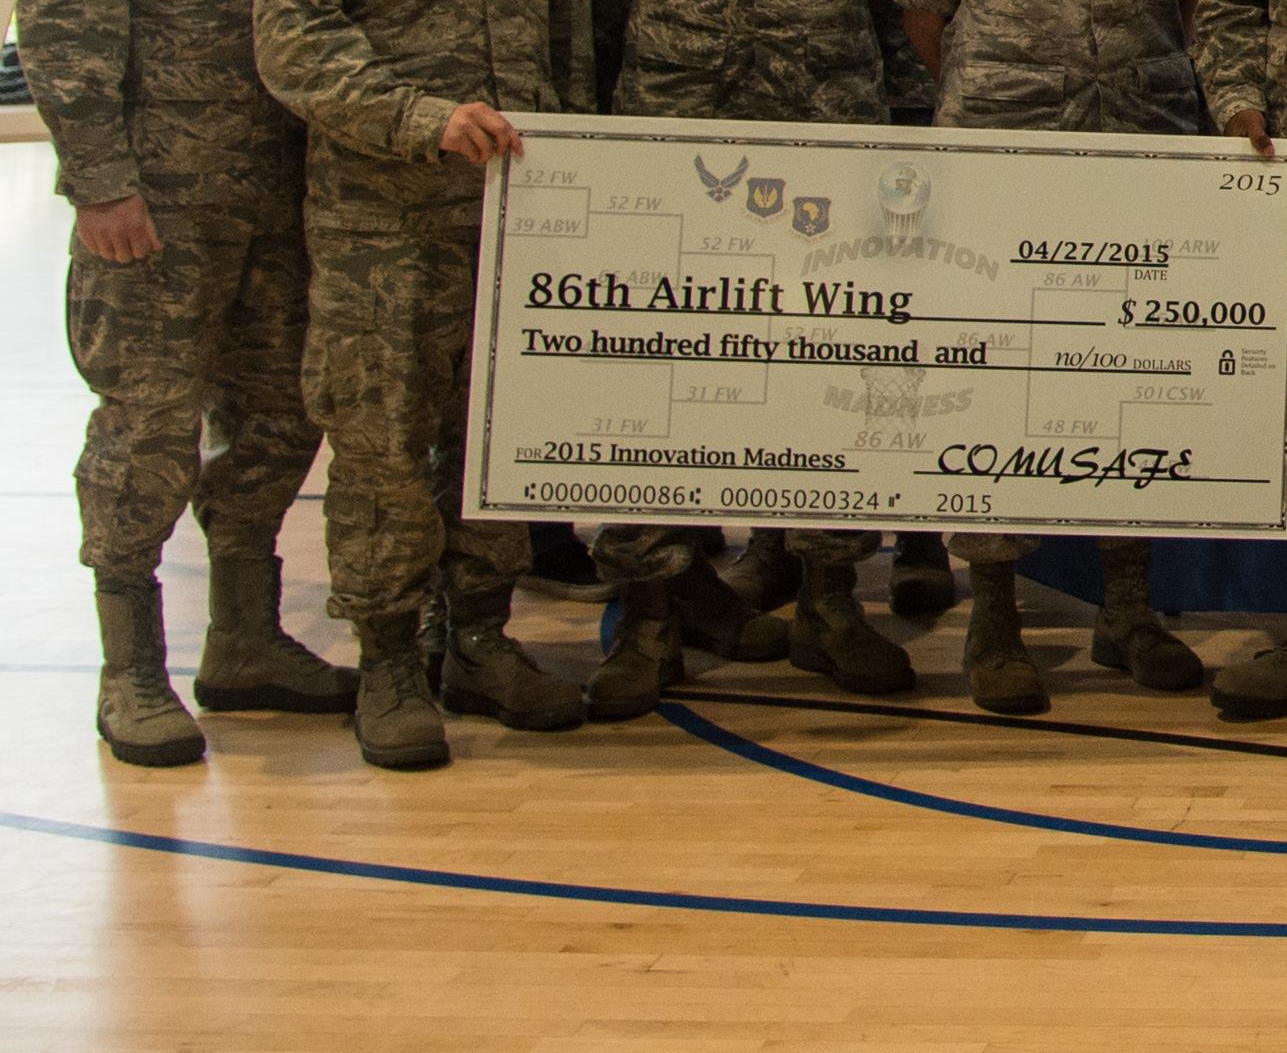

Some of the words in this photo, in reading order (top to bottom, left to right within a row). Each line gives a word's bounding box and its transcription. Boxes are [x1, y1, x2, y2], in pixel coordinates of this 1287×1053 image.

[522, 169, 545, 184] 52
[550, 170, 578, 185] FW
[1219, 173, 1282, 196] 2015
[606, 196, 629, 210] 52
[634, 197, 662, 211] FW
[511, 218, 535, 233] 39
[541, 219, 582, 234] ABW
[701, 237, 722, 250] 52
[728, 238, 755, 252] FW
[1018, 240, 1169, 264] 04/27/2015
[1178, 240, 1221, 254] ARW
[800, 235, 1000, 282] INNOVATION
[1043, 272, 1066, 286] 86
[1071, 273, 1102, 287] AW
[1134, 269, 1168, 281] DATE
[528, 272, 632, 309] 86th
[647, 275, 784, 313] Airlift
[802, 281, 913, 325] Wing
[1118, 299, 1136, 326] $
[1145, 300, 1266, 327] 250,000
[810, 327, 838, 341] FW
[985, 333, 1015, 348] AW
[522, 329, 582, 353] Two
[591, 330, 711, 357] hundred
[719, 333, 780, 363] fifty
[787, 336, 919, 363] thousand
[935, 342, 987, 365] and
[1055, 346, 1127, 369] no/100
[1133, 359, 1192, 371] DOLLARS
[686, 386, 708, 401] 31
[715, 387, 742, 401] FW
[822, 385, 975, 418] MADNESS
[593, 418, 614, 433] 31
[620, 419, 649, 434] FW
[1043, 420, 1066, 433] 48
[1072, 421, 1099, 435] FW
[854, 431, 882, 448] 86
[889, 432, 927, 449] AW
[516, 447, 542, 460] FOR
[544, 442, 601, 462] 2015
[609, 443, 737, 466] Innovation
[743, 447, 846, 469] Madness
[936, 493, 993, 514] 2015
